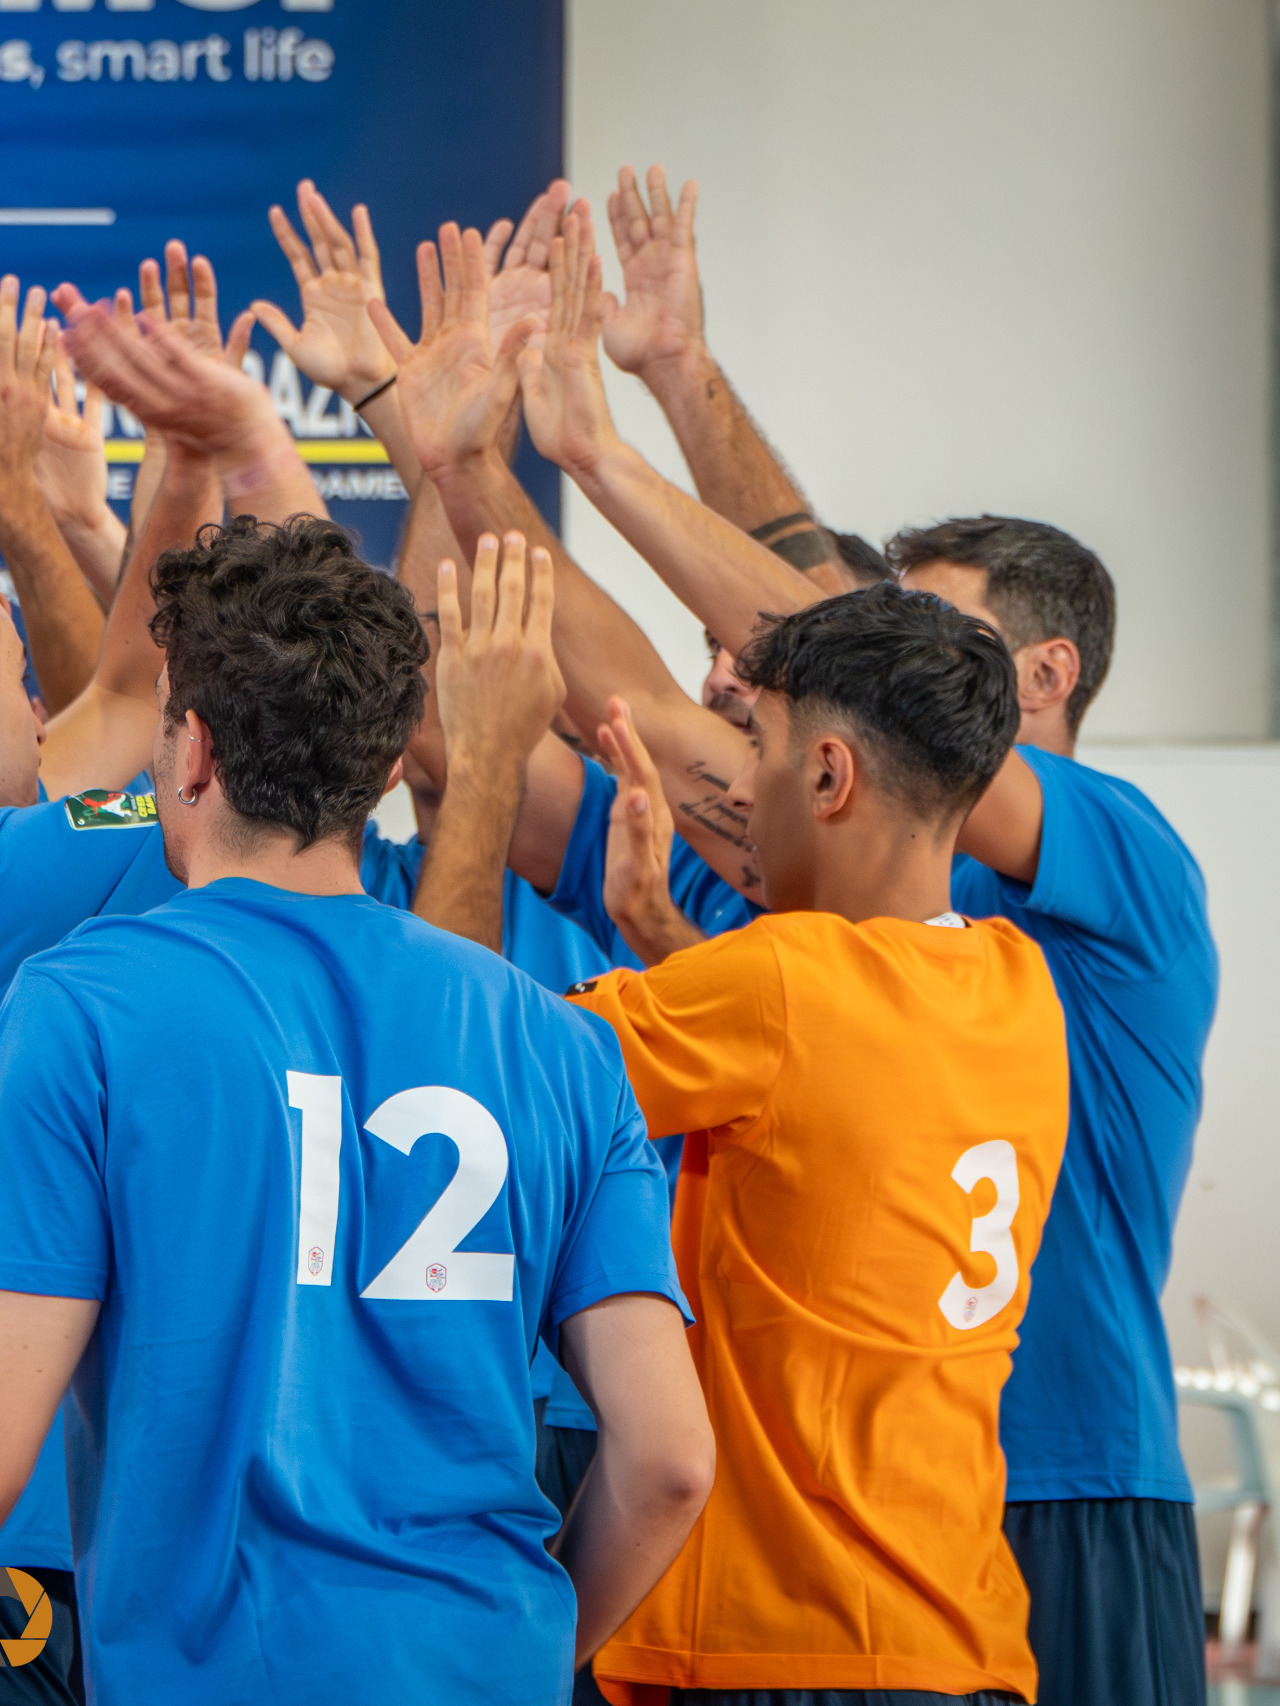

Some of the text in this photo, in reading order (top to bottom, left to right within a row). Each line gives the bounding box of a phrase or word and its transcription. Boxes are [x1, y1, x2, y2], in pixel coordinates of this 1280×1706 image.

[56, 33, 232, 83] smart
[243, 26, 336, 83] life
[286, 1070, 515, 1301] 12
[937, 1139, 1020, 1330] 3
